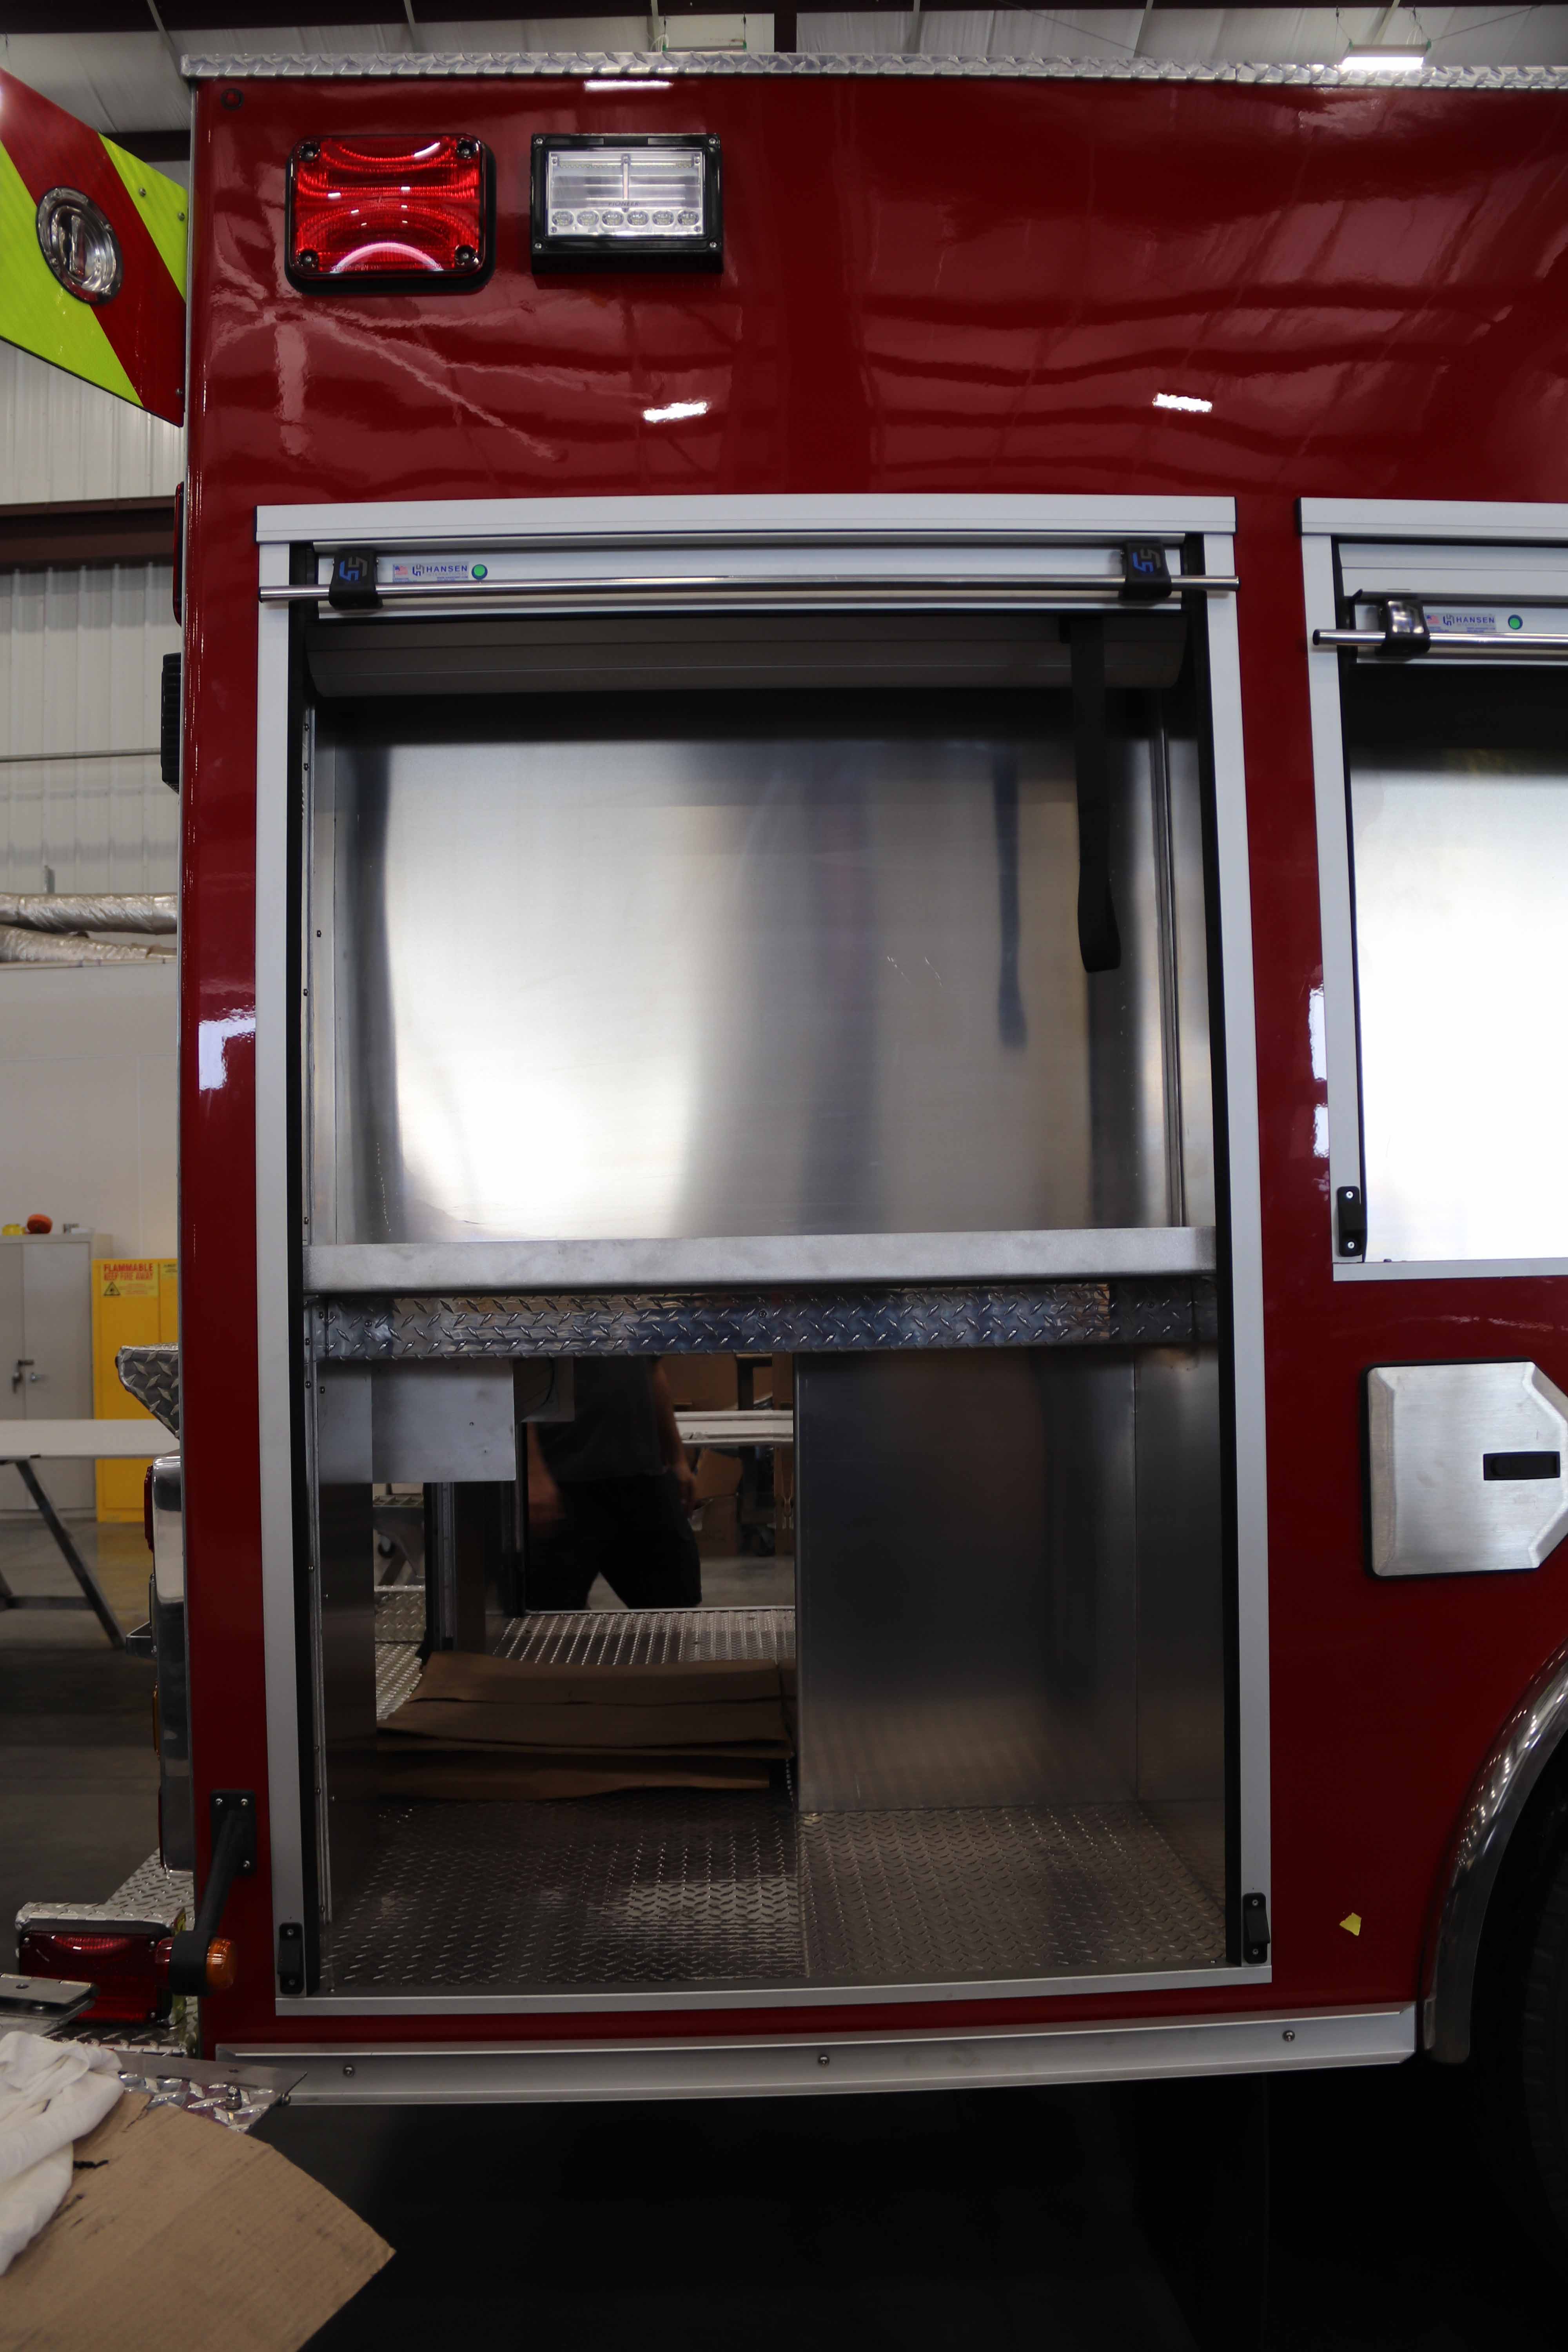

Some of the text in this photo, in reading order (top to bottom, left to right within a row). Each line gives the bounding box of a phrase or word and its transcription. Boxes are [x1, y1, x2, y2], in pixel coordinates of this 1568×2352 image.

[103, 1263, 153, 1272] FLAMMABLE
[103, 1272, 118, 1281] KEEP
[120, 1272, 133, 1280] FIRE
